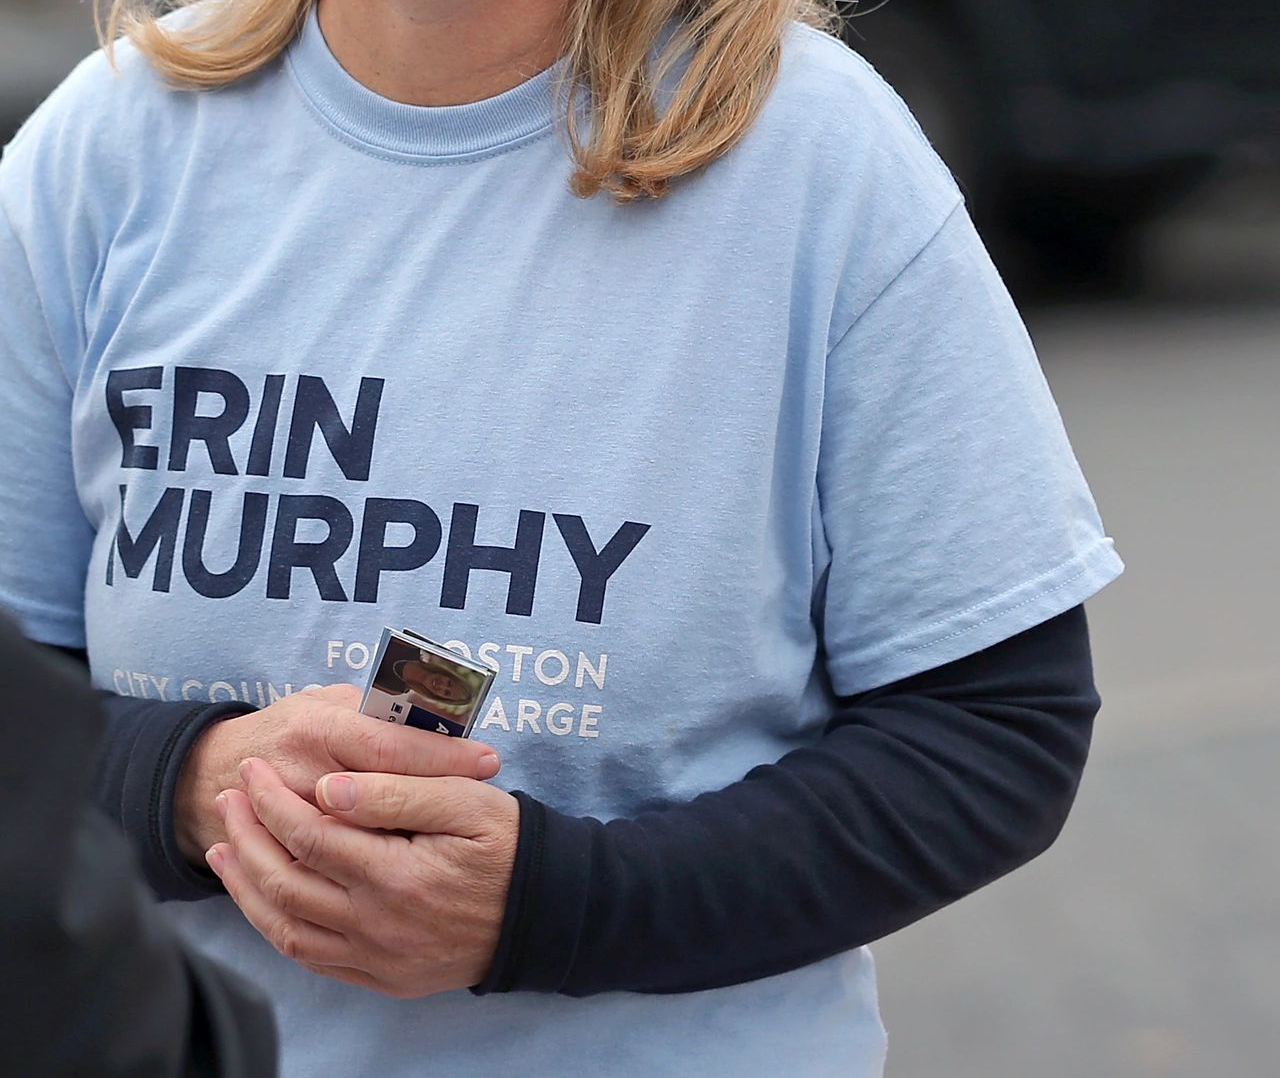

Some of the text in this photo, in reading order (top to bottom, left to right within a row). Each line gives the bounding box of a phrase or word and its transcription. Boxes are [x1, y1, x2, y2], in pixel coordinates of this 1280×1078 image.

[106, 366, 385, 482] ERIN
[105, 484, 652, 625] MURPHY
[113, 668, 169, 702] CITY
[181, 679, 324, 710] COUN
[473, 696, 602, 738] ARGE
[327, 639, 608, 690] FO STON
